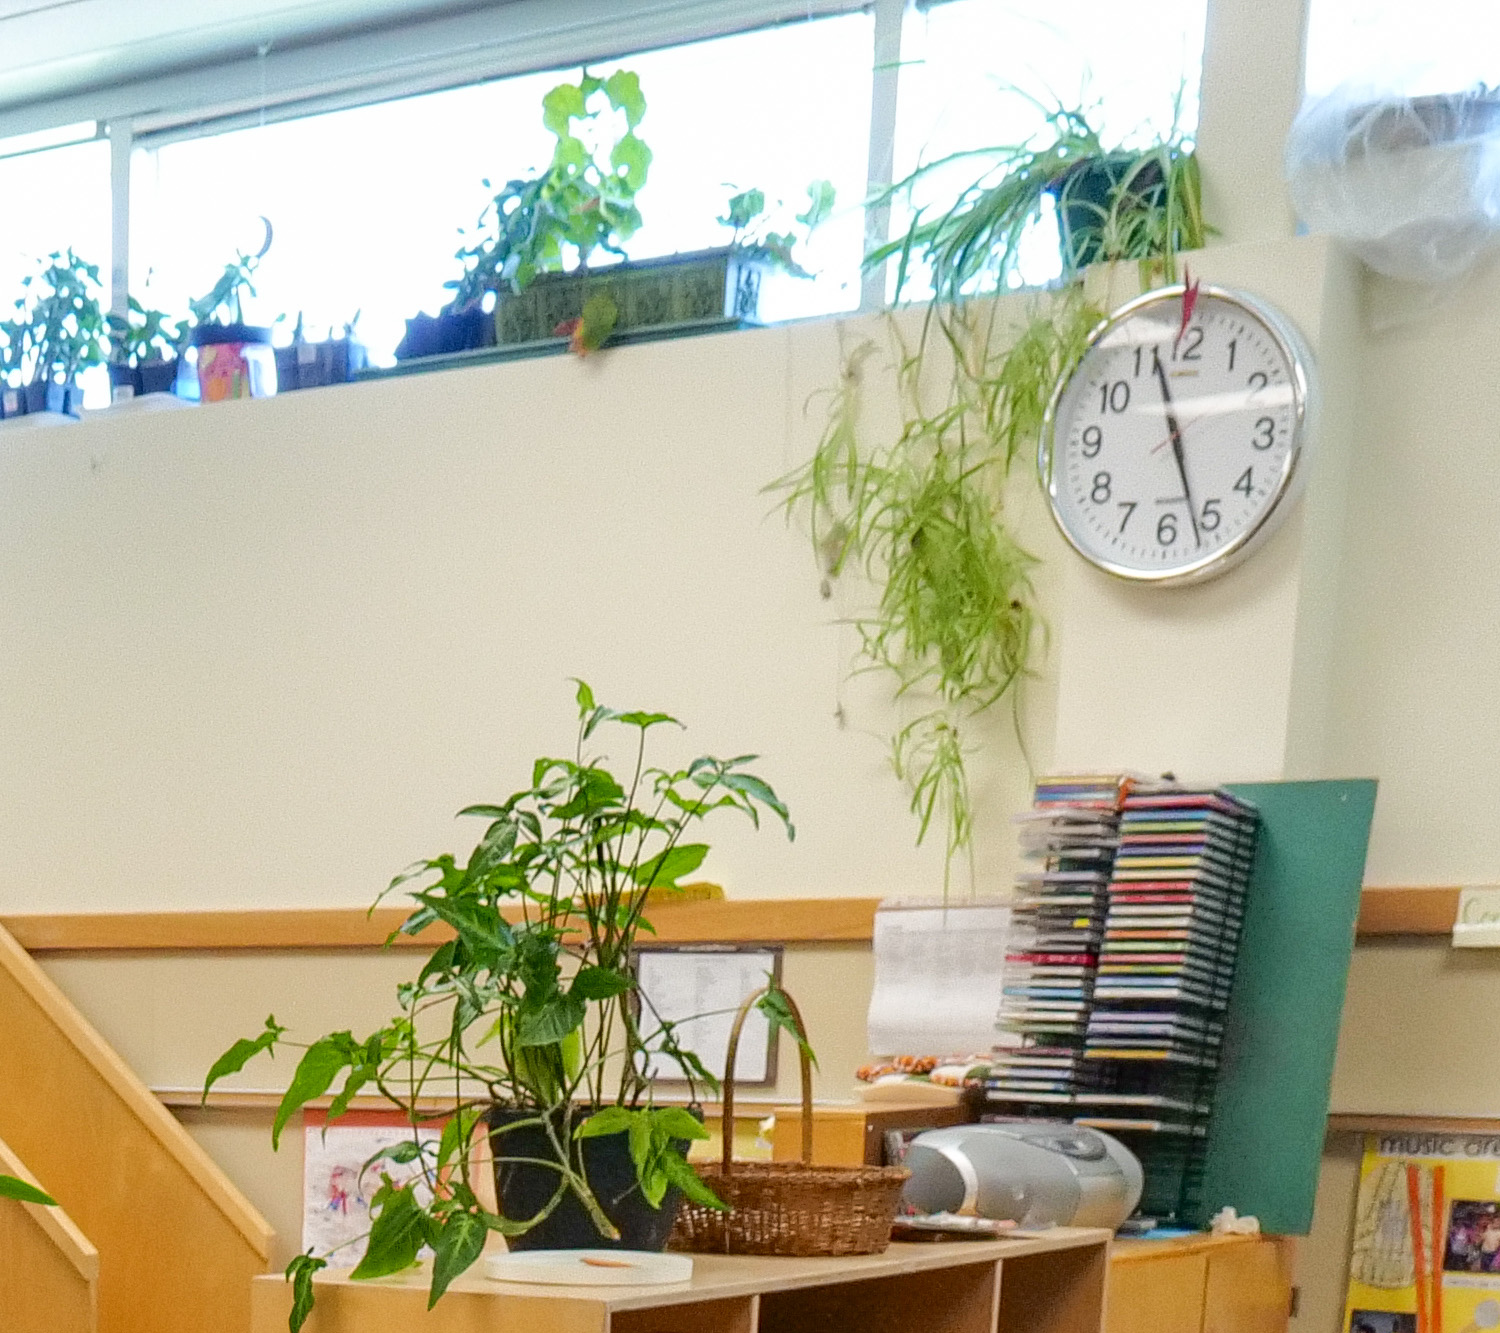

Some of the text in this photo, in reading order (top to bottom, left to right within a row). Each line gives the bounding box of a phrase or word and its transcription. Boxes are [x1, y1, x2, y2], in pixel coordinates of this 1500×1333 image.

[1133, 344, 1159, 377] 11
[1228, 339, 1237, 371] 1
[1100, 381, 1130, 413] 10
[1248, 372, 1268, 404] 2
[1081, 426, 1102, 458] 9
[1251, 416, 1275, 450] 3
[1091, 471, 1111, 503] 8
[1233, 466, 1254, 497] 4
[1118, 502, 1137, 533] 7
[1157, 513, 1177, 545] 6
[1200, 500, 1221, 531] 5
[1379, 1136, 1453, 1156] music
